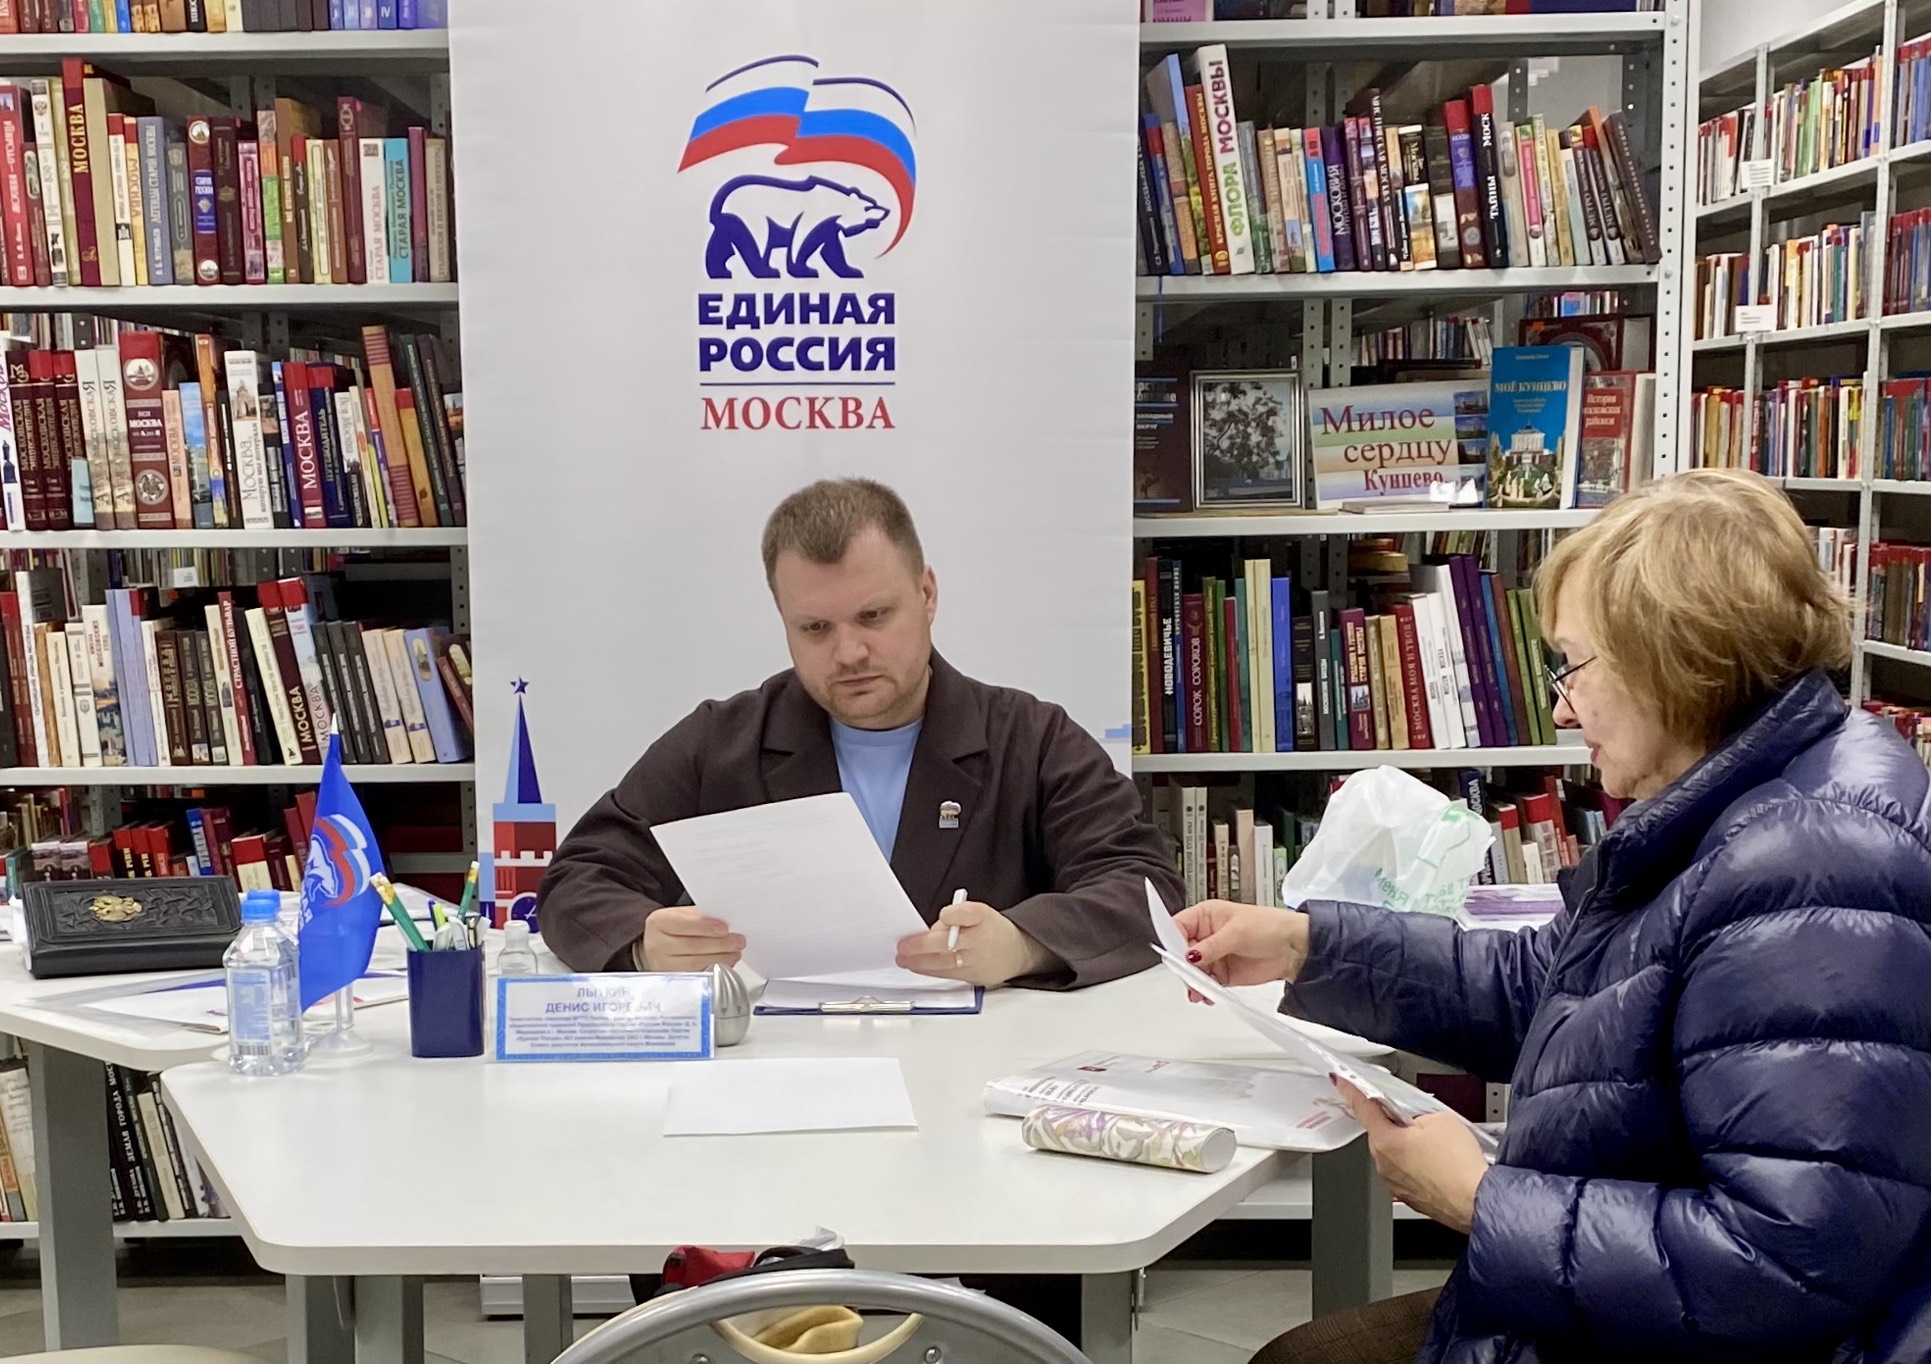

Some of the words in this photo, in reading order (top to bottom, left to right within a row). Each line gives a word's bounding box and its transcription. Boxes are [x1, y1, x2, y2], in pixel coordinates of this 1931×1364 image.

[381, 6, 391, 18] IV
[1195, 93, 1208, 134] МОСКВЫ
[1208, 59, 1235, 154] МОСКВЫ
[69, 103, 90, 174] МОСКВА
[1481, 113, 1493, 147] МОСК
[1202, 135, 1214, 170] ГОРОДА
[127, 157, 141, 218] МОСКВА
[394, 159, 407, 209] МОСКВА
[1207, 171, 1219, 202] КНИГА
[1221, 161, 1245, 236] ФЛОРА
[1327, 164, 1346, 236] МОСКОВИЯ
[1486, 175, 1500, 219] ТАЙНЫ
[371, 185, 383, 233] МОСКВА
[1211, 204, 1224, 244] КРАСНАЯ
[1584, 192, 1598, 227] МЕТРО
[1601, 192, 1615, 227] МЕТРО
[397, 212, 409, 259] СТАРАЯ
[373, 237, 385, 280] СТАРАЯ
[698, 292, 896, 330] ЕДИНАЯ
[699, 336, 896, 372] РОССИЯ
[1495, 380, 1517, 394] МОЁ
[1519, 380, 1567, 393] КУНЦЕВО
[1587, 393, 1617, 406] История
[129, 418, 163, 429] МОСКВА
[701, 396, 896, 430] МОСКВА
[1319, 404, 1435, 435] Милое
[12, 399, 29, 472] МОСКОВСКАЯ
[35, 397, 51, 471] МОСКОВСКАЯ
[168, 426, 182, 465] МОСКВА
[251, 422, 262, 461] потеряли
[294, 410, 318, 489] МОСКВА
[318, 408, 334, 482] ПУТЕВОДИТЕЛЬ
[239, 434, 258, 500] Москва,
[255, 462, 262, 475] мы
[1344, 439, 1453, 469] сердцу
[256, 476, 267, 513] которую
[222, 600, 237, 638] БУЛЬВАР
[1403, 624, 1414, 650] ТВОЯ
[229, 638, 244, 689] СТРАСТНОЙ
[1162, 617, 1175, 696] НОВОДЕВИЧЬЕ
[1191, 636, 1201, 686] СОРОКОВ
[1407, 652, 1415, 660] И
[1409, 662, 1418, 686] МОЯ
[289, 685, 314, 744] МОСКВА
[309, 685, 330, 743] МОСКВА
[1192, 689, 1203, 727] СОРОК
[1411, 687, 1423, 731] МОСКВА
[545, 1002, 590, 1014] ДЕНИС
[576, 987, 631, 998] ЛЫКИН
[112, 1089, 128, 1127] ГОРОДА
[121, 1129, 136, 1162] ЗЕМЛЯ
